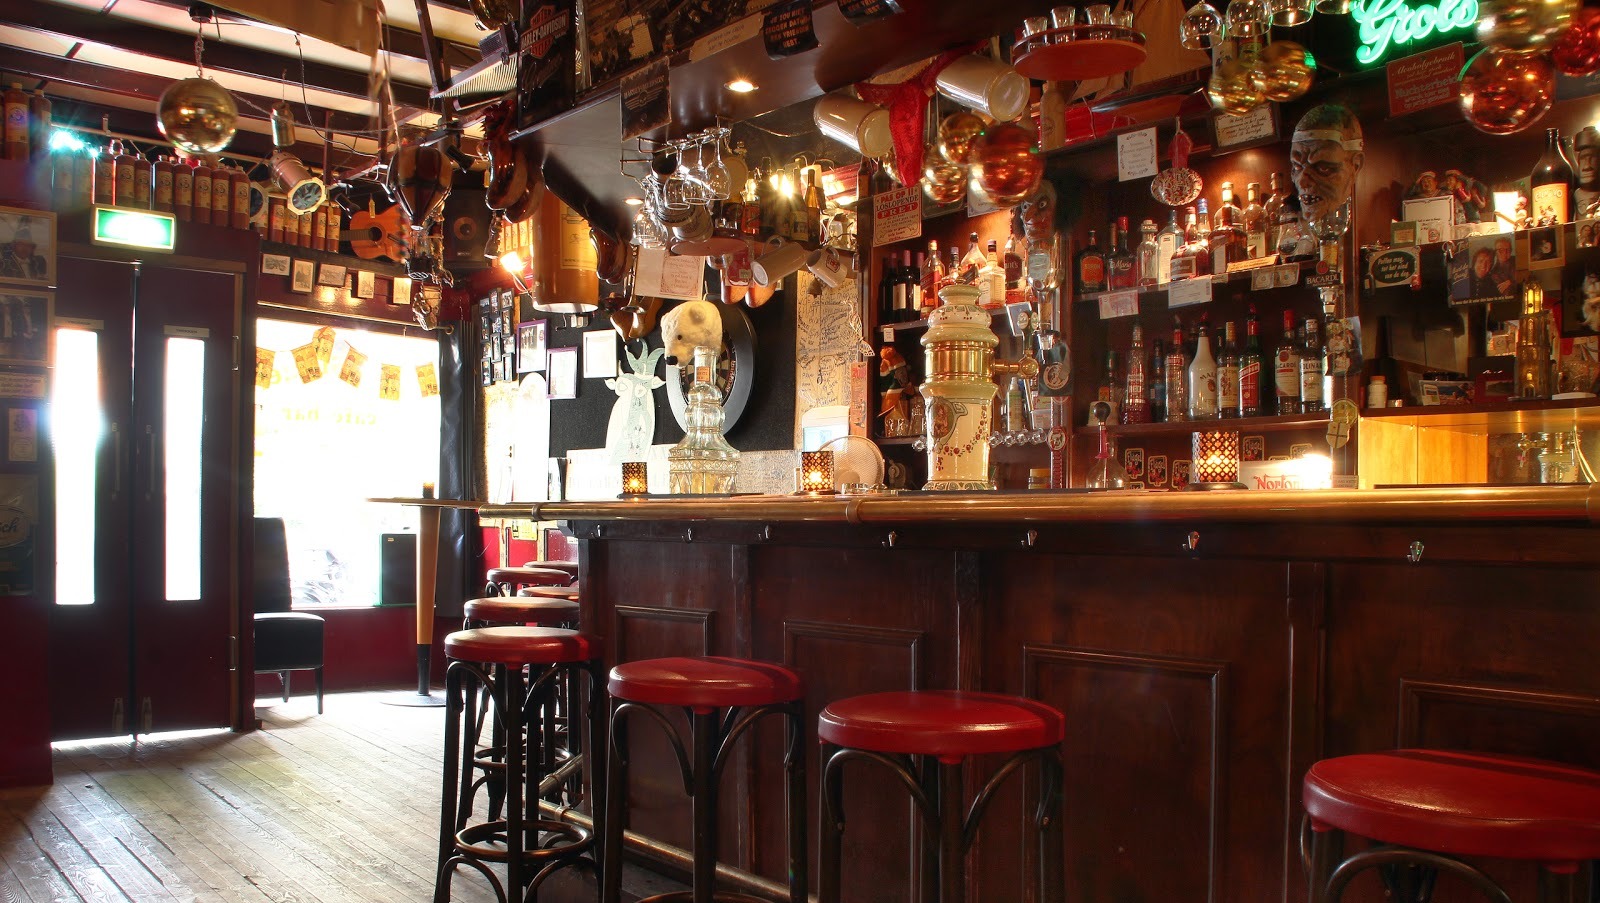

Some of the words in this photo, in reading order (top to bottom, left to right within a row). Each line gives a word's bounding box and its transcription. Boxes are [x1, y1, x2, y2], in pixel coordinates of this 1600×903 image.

[521, 12, 567, 51] HARLEY-DAVIDSON
[876, 194, 919, 212] LOSLOPENDE
[880, 194, 894, 204] PAS
[895, 190, 906, 200] OP
[881, 202, 916, 218] FRET
[1306, 274, 1340, 286] BACARDI
